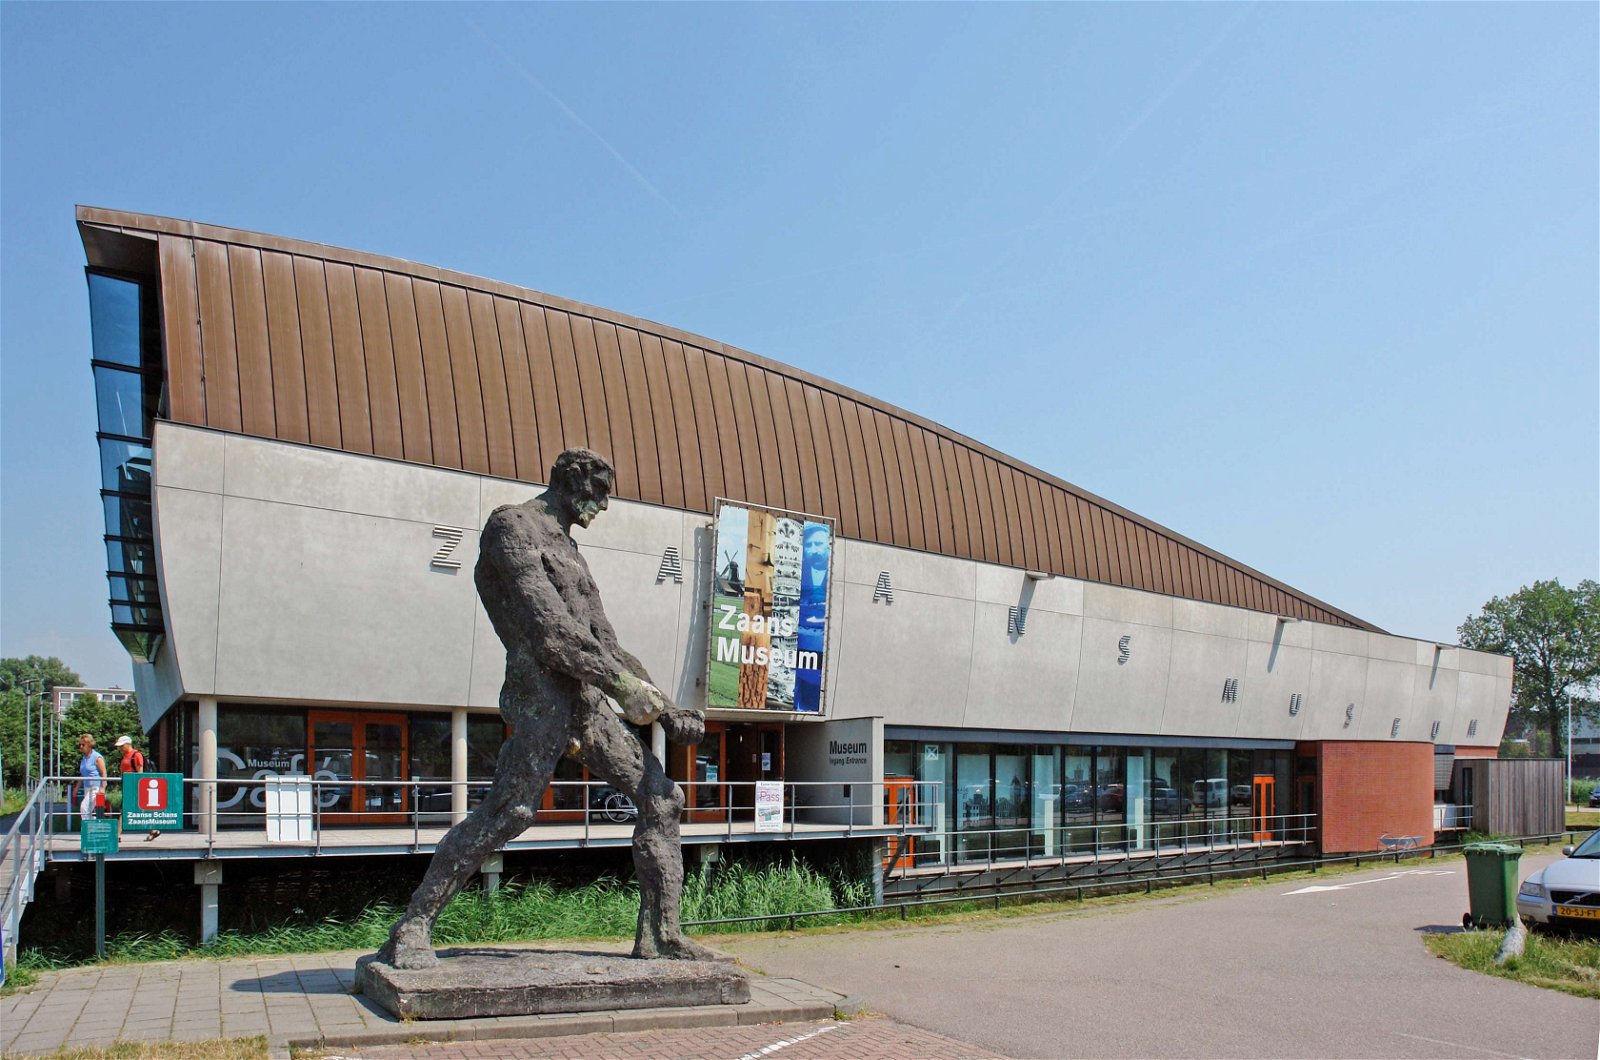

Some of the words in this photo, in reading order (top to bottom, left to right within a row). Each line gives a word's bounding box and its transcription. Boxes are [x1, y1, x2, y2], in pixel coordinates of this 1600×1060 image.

[718, 604, 794, 637] Zaans
[716, 637, 818, 670] Museum
[829, 740, 867, 754] Museum
[247, 758, 290, 769] Museum
[1560, 906, 1598, 917] 20-SJ-FT
